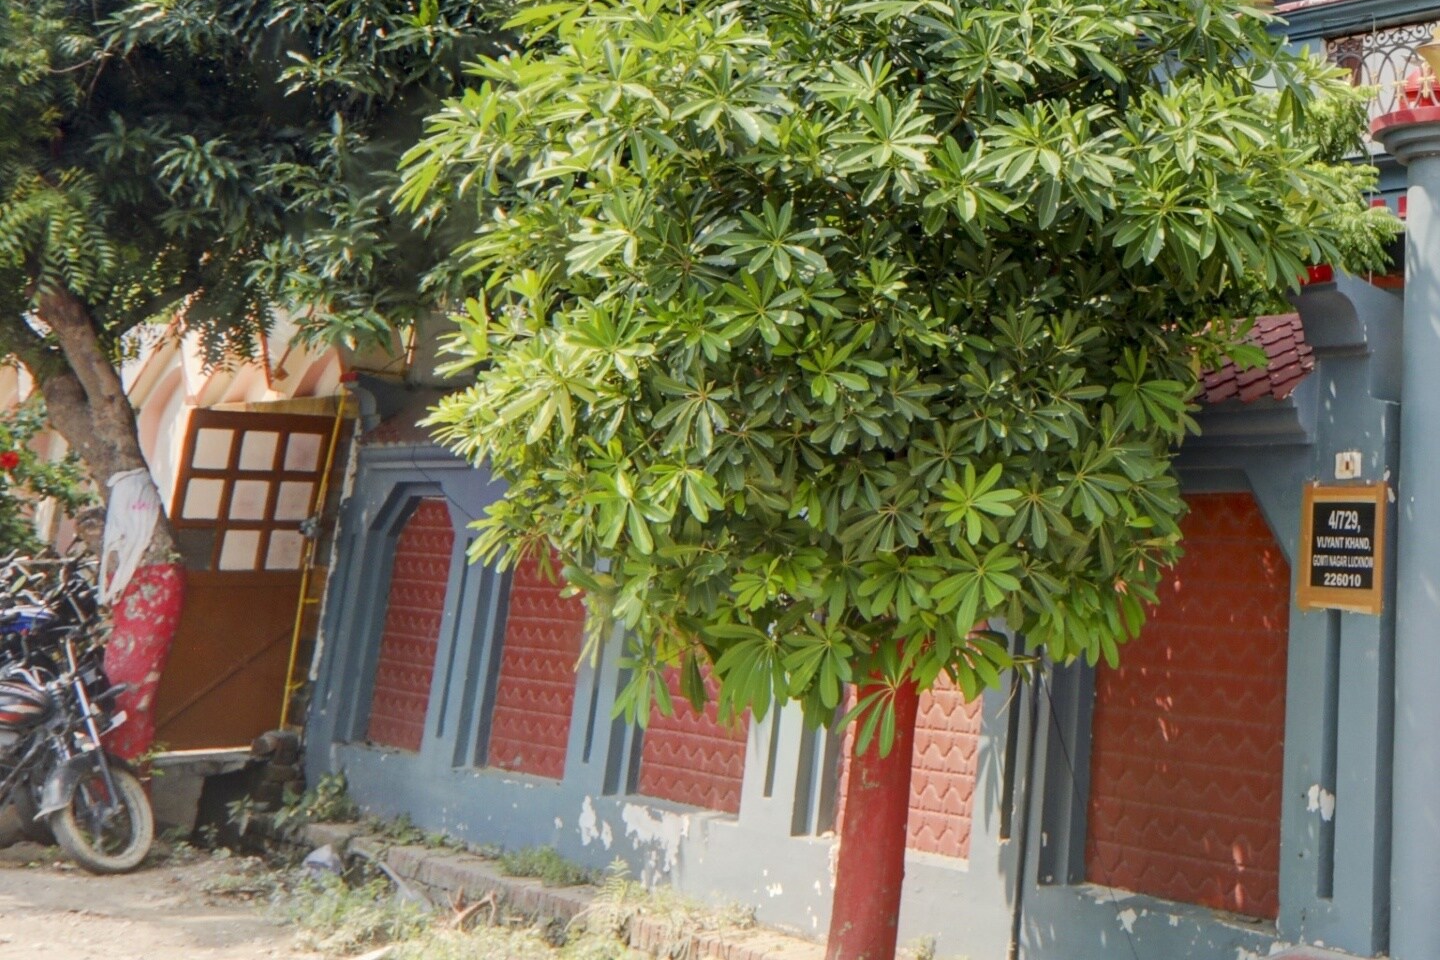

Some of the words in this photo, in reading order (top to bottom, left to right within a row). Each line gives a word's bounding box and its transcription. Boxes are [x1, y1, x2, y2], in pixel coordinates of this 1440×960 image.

[1328, 510, 1361, 533] 4/729,
[1345, 537, 1371, 551] KHAND,
[1329, 555, 1347, 568] NAGAR
[1323, 572, 1362, 587] 226010
